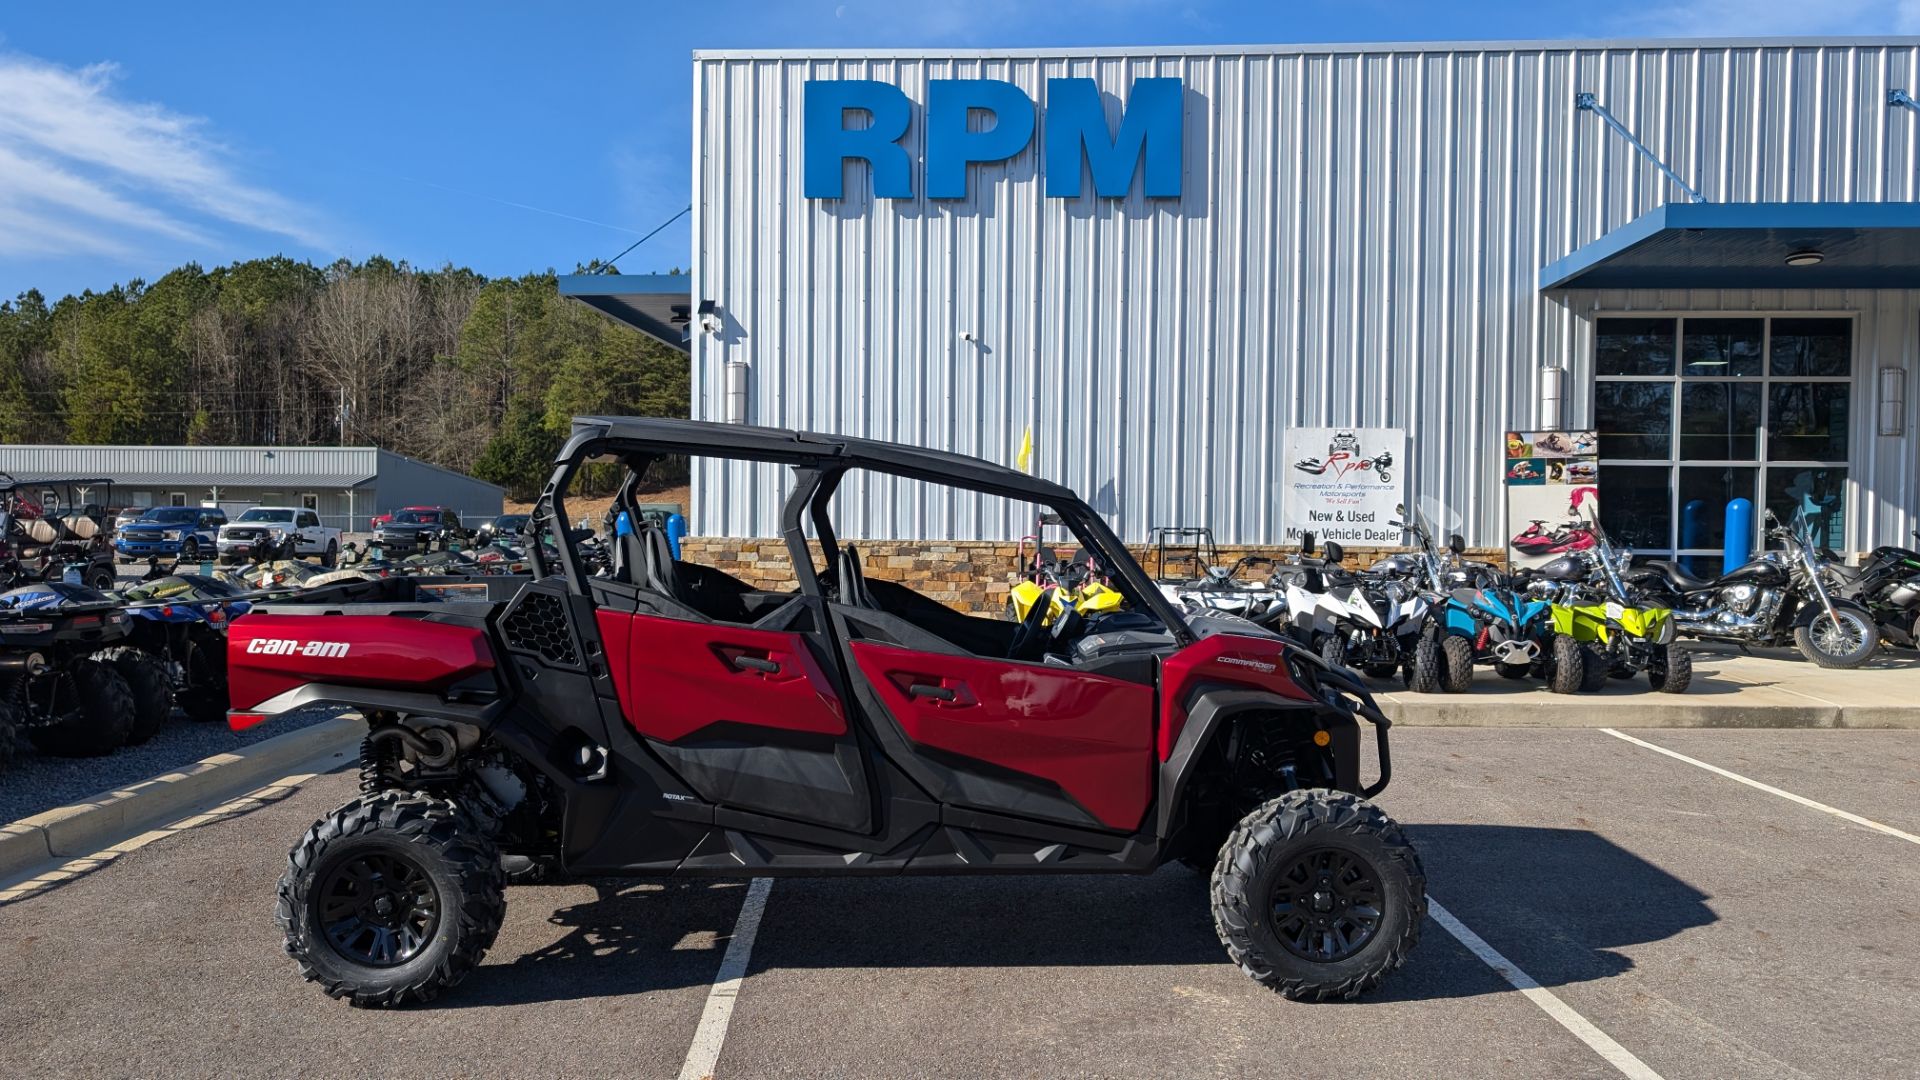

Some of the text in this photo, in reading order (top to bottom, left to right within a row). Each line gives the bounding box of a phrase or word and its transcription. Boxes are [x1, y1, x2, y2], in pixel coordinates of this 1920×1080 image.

[804, 78, 1184, 199] RPM
[1294, 482, 1336, 490] Recreation
[1345, 483, 1395, 491] Performance
[1309, 510, 1375, 522] New & Used
[1321, 528, 1362, 541] Vehicle
[1364, 528, 1401, 541] Dealer
[246, 638, 351, 658] can-am
[1217, 656, 1276, 669] COMMANDER
